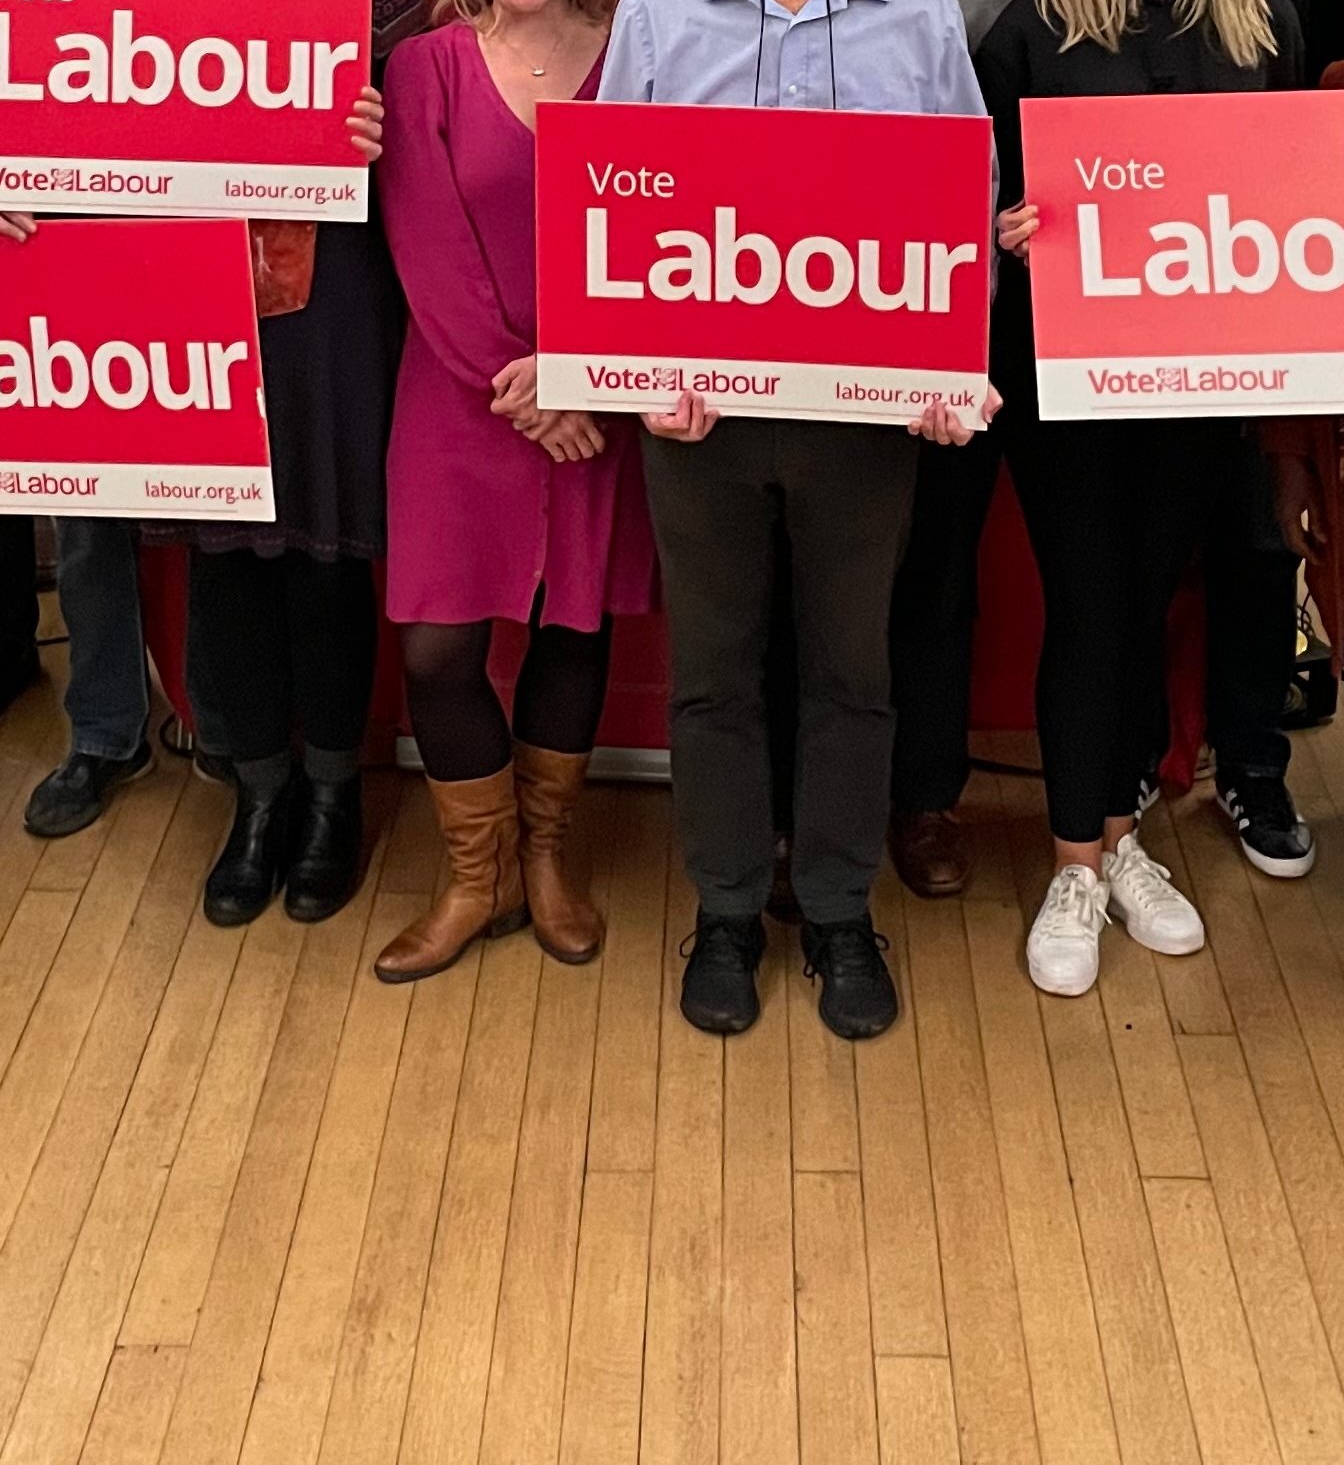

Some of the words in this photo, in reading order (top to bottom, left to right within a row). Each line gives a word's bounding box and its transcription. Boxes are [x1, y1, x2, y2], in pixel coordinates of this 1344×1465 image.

[73, 169, 173, 195] Labour
[586, 162, 675, 198] Vote
[1075, 156, 1166, 191] Vote
[224, 180, 356, 204] labour.org.uk
[585, 206, 978, 313] Labour
[586, 365, 651, 391] Vote
[1088, 369, 1156, 394] Vote
[1183, 366, 1290, 392] Labour
[14, 472, 99, 496] Labour
[144, 481, 263, 504] labour.org.uk
